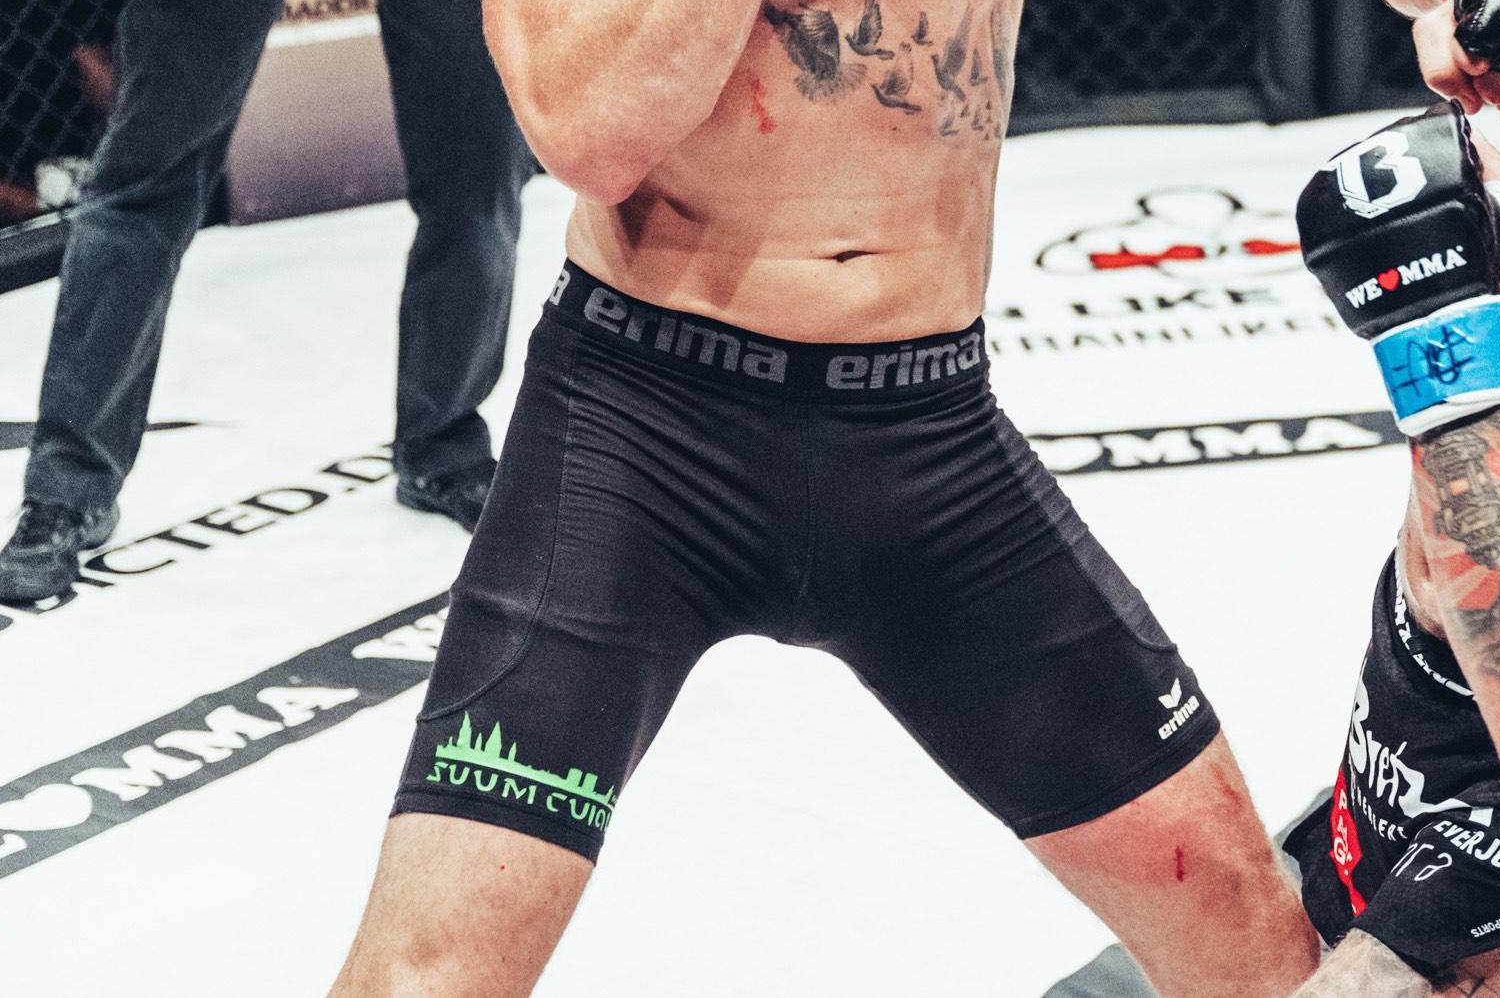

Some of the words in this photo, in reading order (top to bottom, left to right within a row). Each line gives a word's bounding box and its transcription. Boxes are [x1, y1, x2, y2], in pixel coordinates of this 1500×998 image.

[1345, 277, 1383, 309] WE
[1398, 248, 1467, 286] MMA
[583, 286, 789, 385] erima
[825, 331, 982, 390] erima
[1101, 416, 1384, 469] MMA
[70, 685, 360, 802] MMA
[1158, 695, 1200, 740] erima
[426, 761, 537, 805] SUUM
